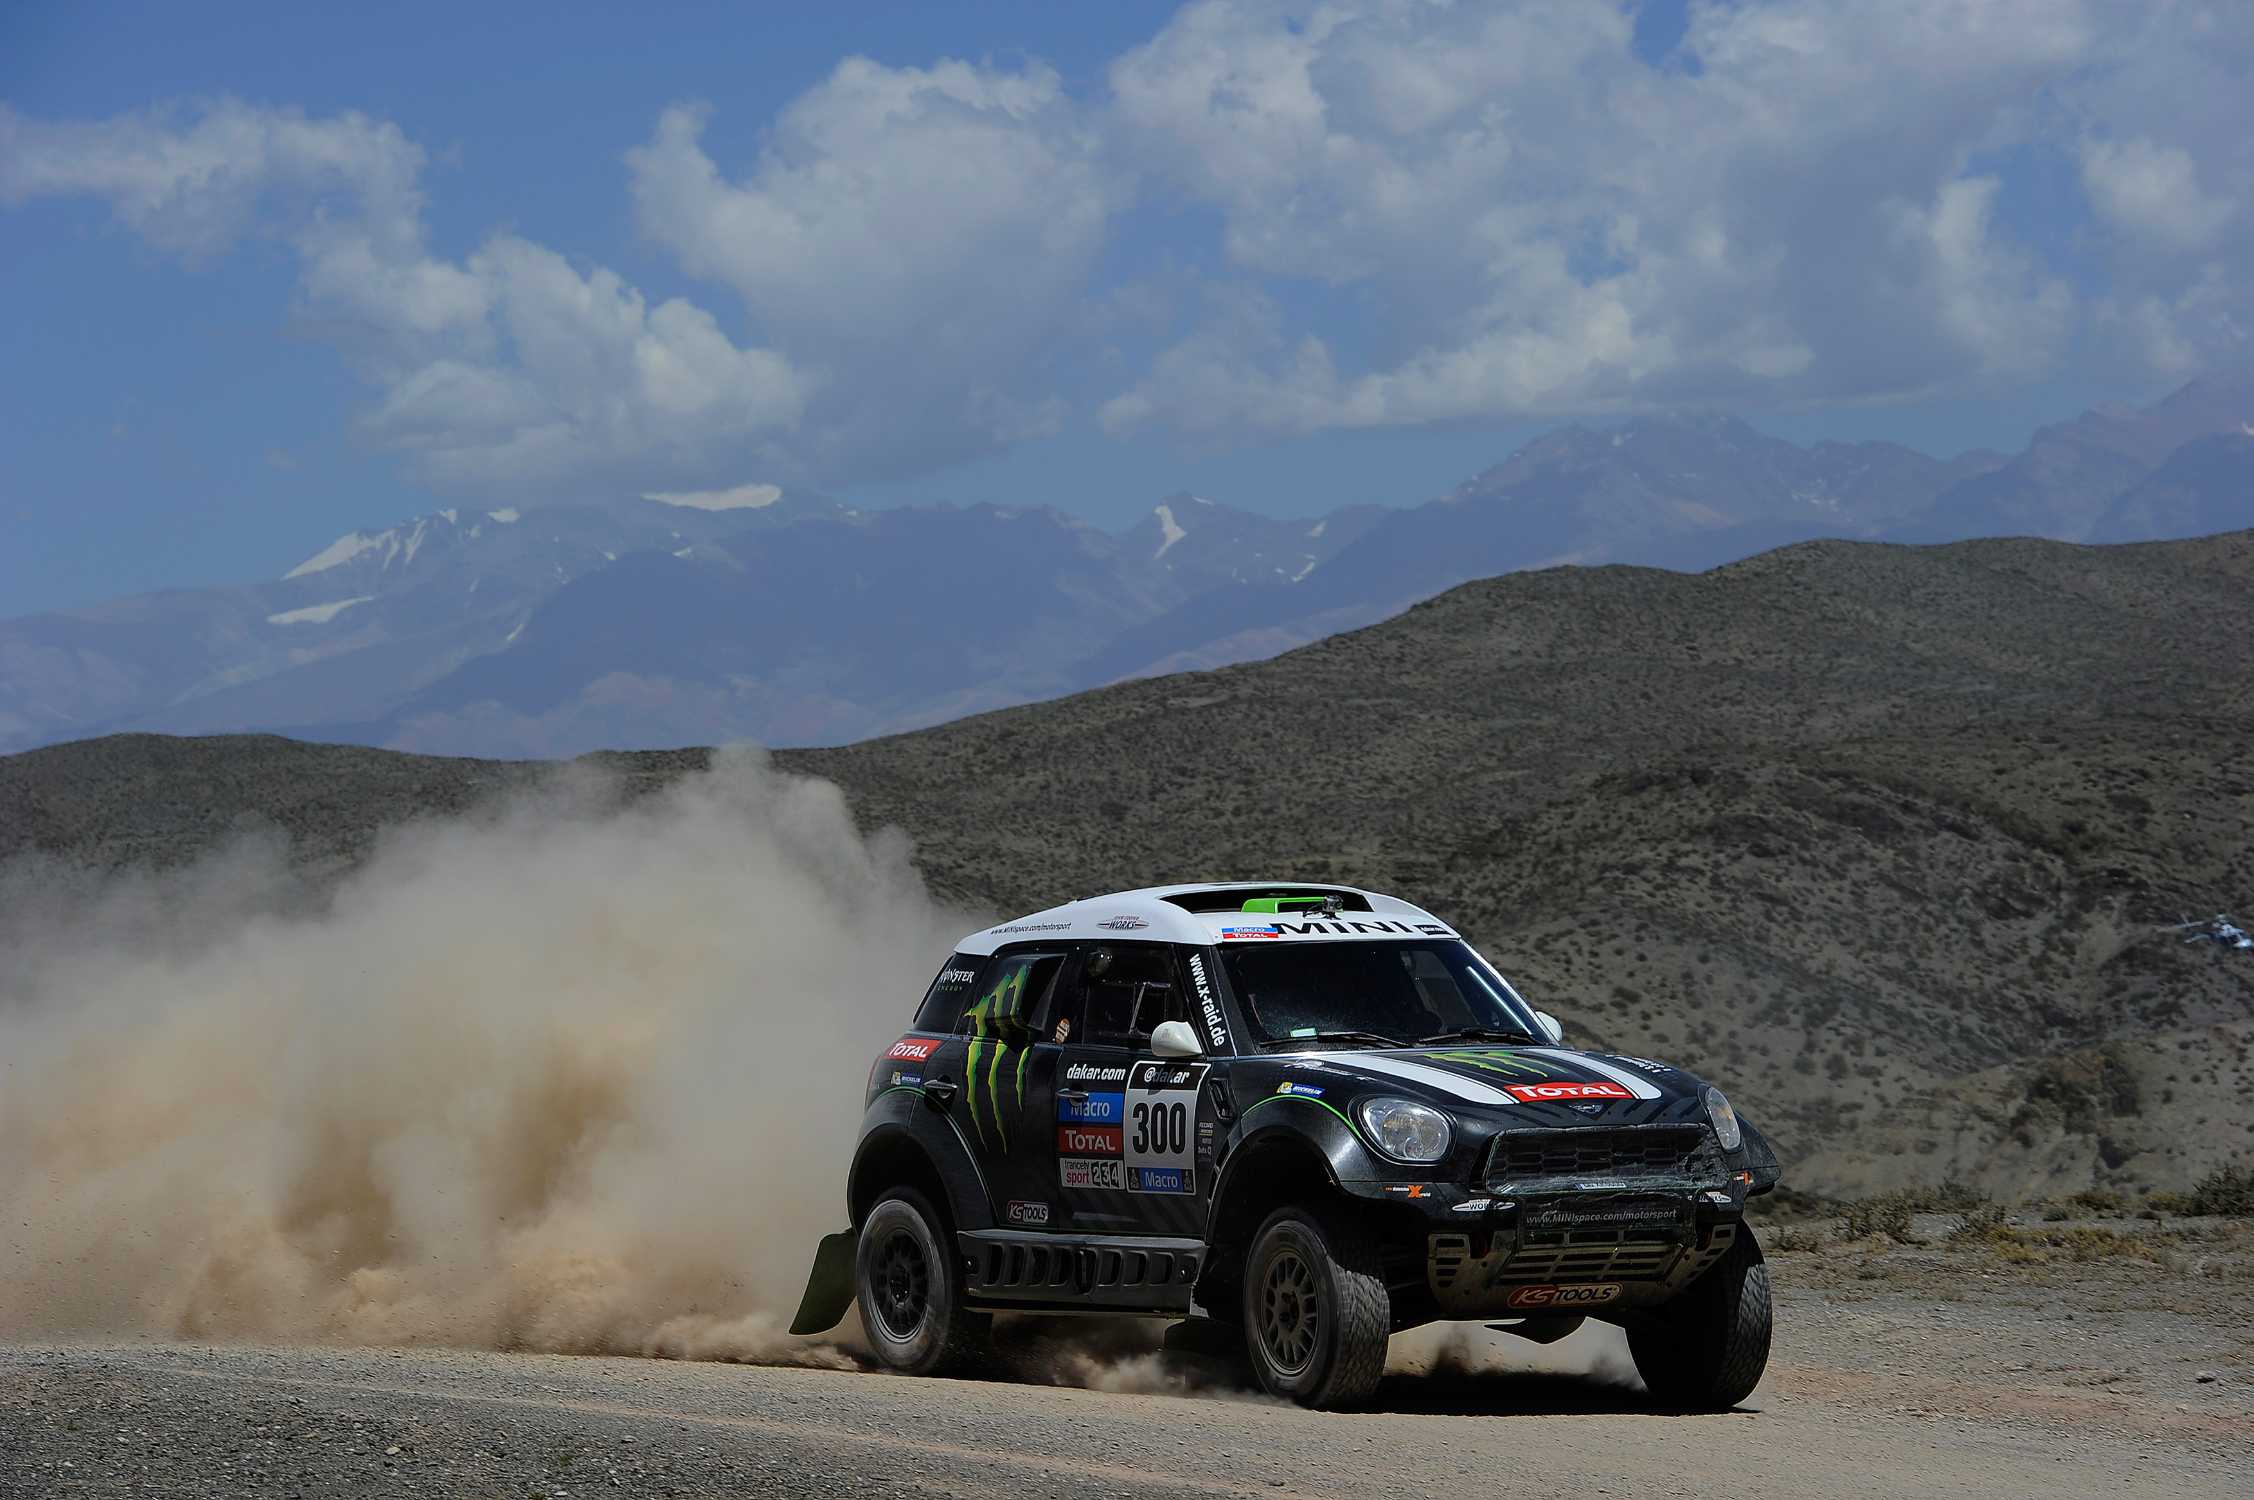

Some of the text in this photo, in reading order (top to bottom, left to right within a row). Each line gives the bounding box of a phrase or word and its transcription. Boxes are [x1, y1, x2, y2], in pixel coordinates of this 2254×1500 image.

[1269, 921, 1413, 934] MINI
[1189, 952, 1226, 1048] www.x-raid.de
[888, 1041, 929, 1058] TOTAL
[1066, 1063, 1127, 1081] dakar.com
[1511, 1085, 1626, 1097] TOTAL
[1132, 1102, 1187, 1154] 300
[1065, 1129, 1116, 1151] TOTAL
[1066, 1170, 1090, 1186] sport
[1144, 1170, 1179, 1188] Macro
[1023, 1203, 1048, 1221] TOOLS
[1552, 1285, 1618, 1301] TOOLS
